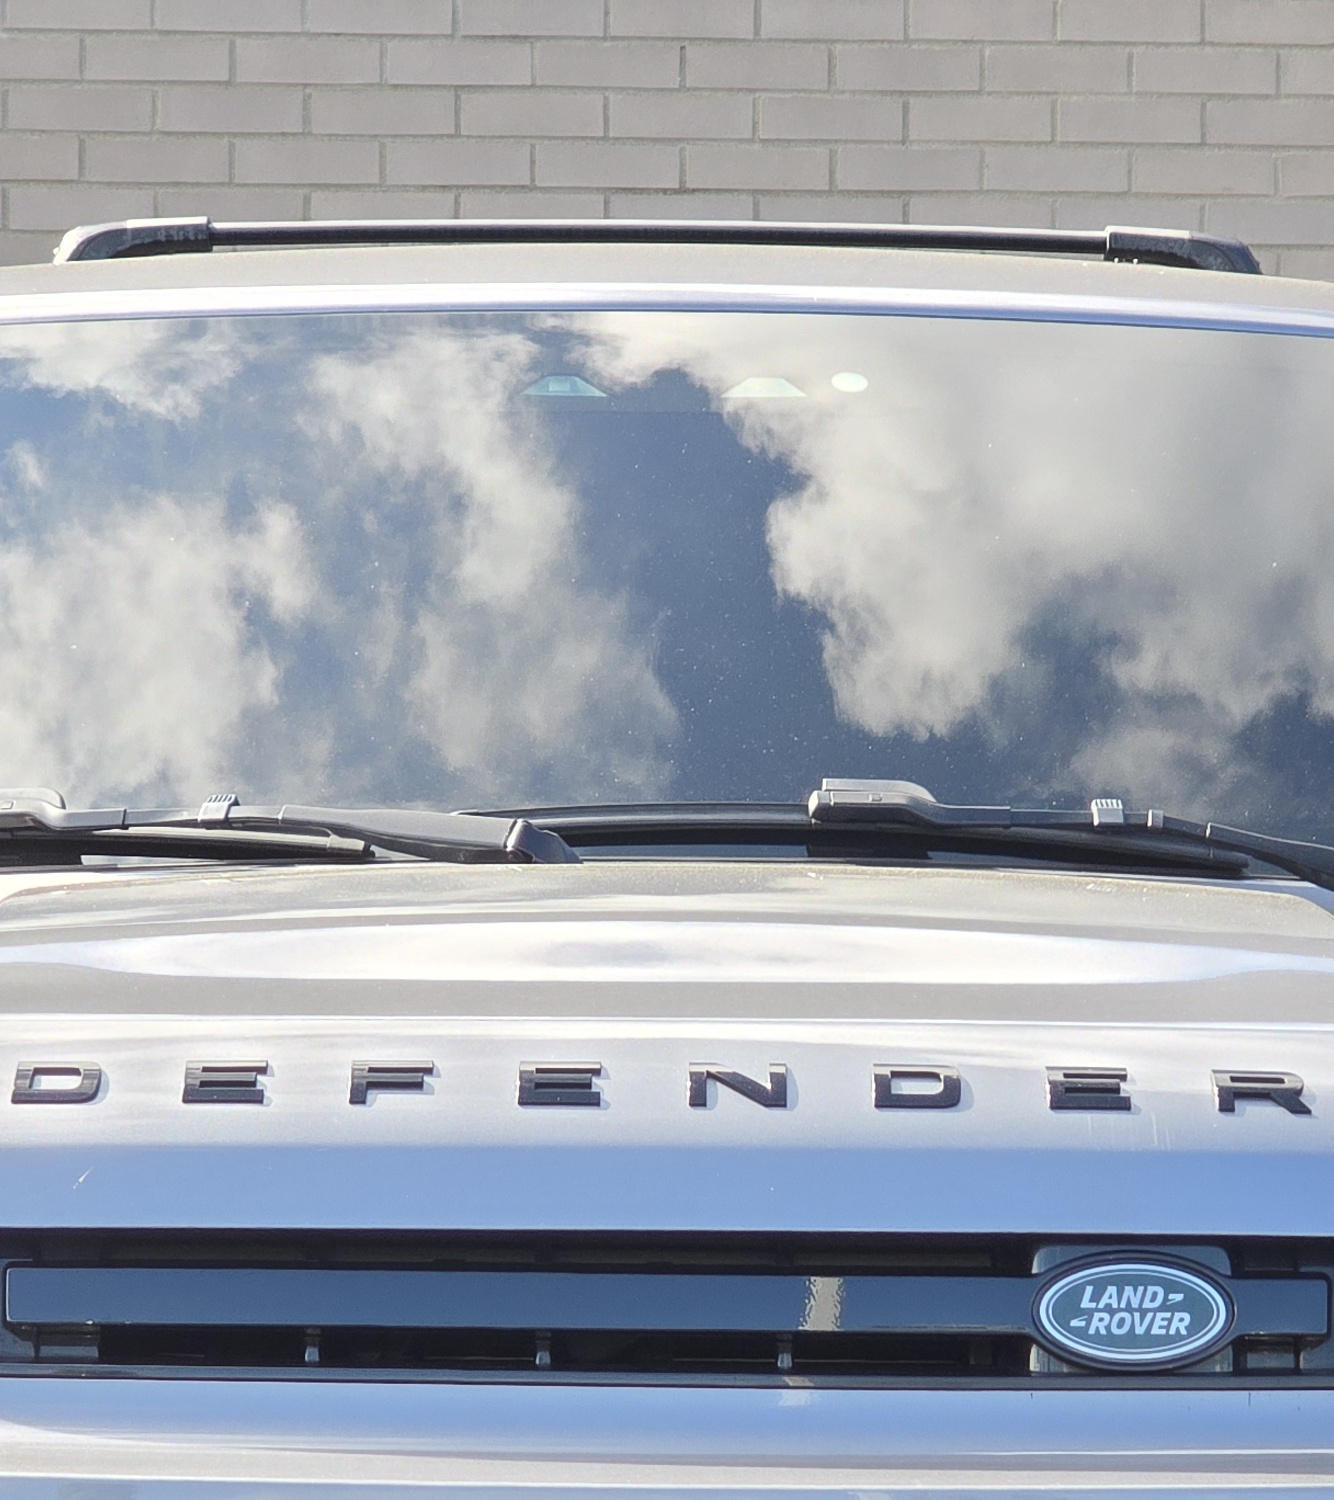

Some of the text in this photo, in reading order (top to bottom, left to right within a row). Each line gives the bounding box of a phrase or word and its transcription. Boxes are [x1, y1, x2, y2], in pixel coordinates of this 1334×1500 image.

[11, 1060, 1312, 1114] DEFENDER
[1080, 1286, 1165, 1308] LAND
[1088, 1312, 1191, 1335] ROVER
